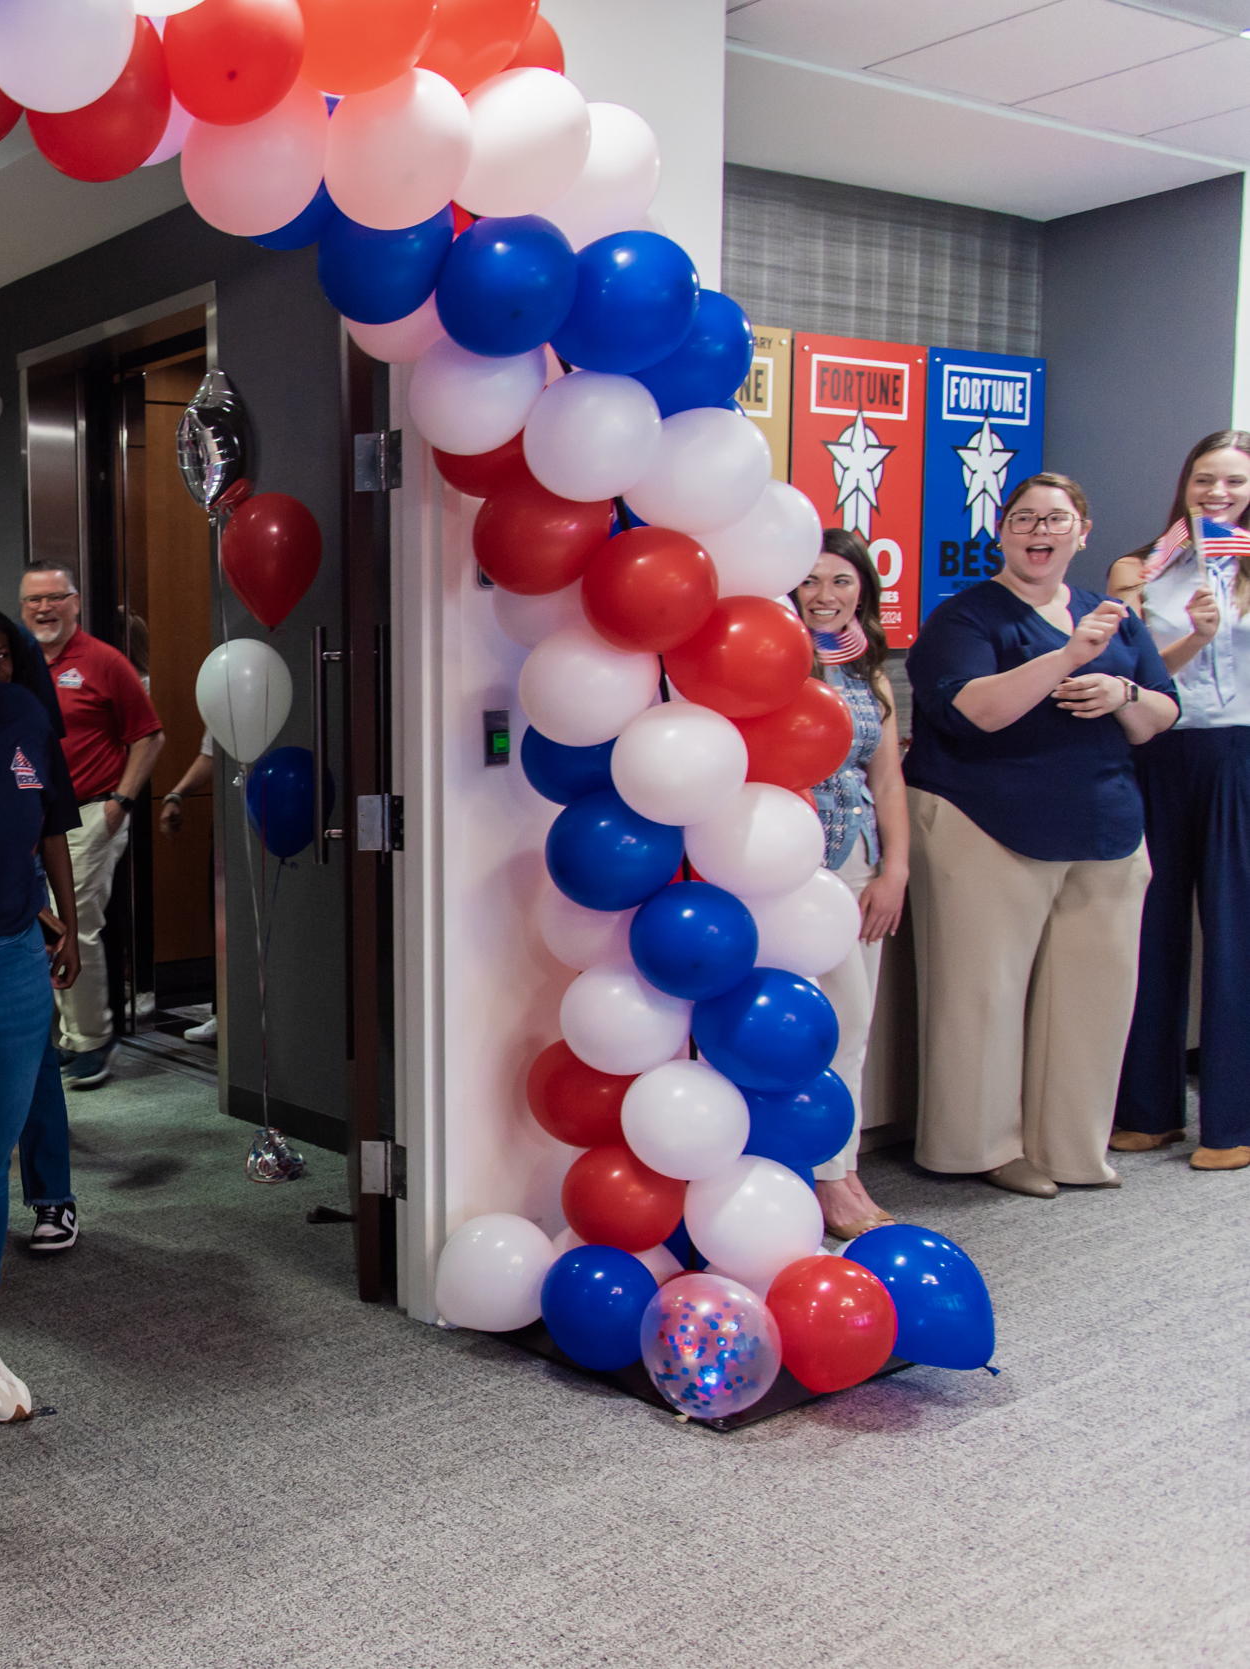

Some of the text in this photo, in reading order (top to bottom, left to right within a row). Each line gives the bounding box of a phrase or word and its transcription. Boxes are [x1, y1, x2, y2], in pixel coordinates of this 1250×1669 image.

[753, 336, 773, 349] ARY
[739, 369, 764, 403] NE
[820, 367, 901, 407] FORTUNE
[949, 376, 1024, 414] FORTUNE
[867, 538, 903, 588] 0
[940, 541, 1003, 577] BES
